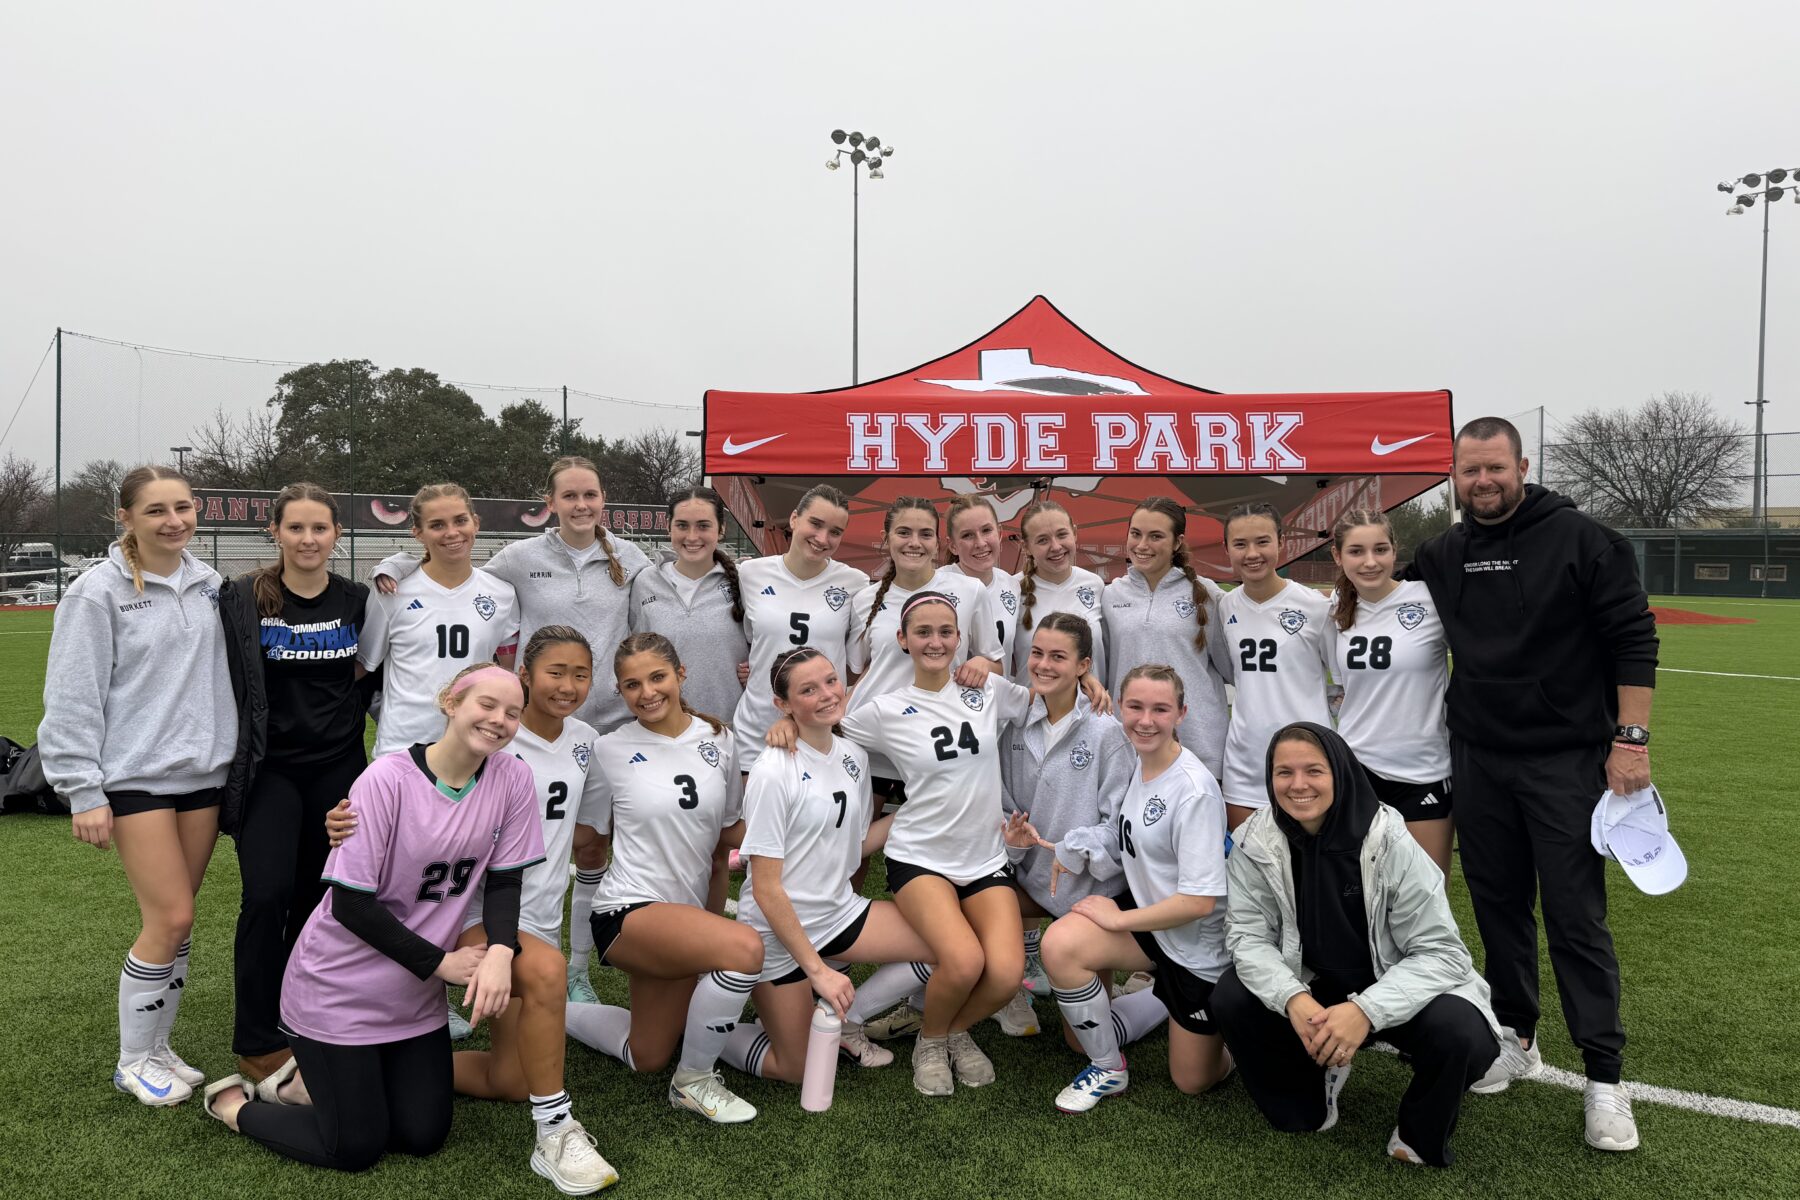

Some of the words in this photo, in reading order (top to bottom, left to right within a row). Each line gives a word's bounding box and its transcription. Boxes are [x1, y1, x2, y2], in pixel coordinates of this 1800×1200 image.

[847, 412, 1067, 472] HYDE
[1092, 412, 1307, 472] PARK
[600, 509, 669, 530] ASEBA
[529, 571, 552, 579] HERRIN
[119, 600, 152, 613] BURKETT
[260, 623, 358, 650] VOLLEYBALL
[436, 624, 470, 659] 10
[788, 611, 811, 646] 5
[282, 643, 358, 660] COUGARS
[1239, 638, 1278, 672] 22
[1346, 635, 1393, 670] 28
[930, 721, 980, 762] 24
[545, 780, 569, 820] 2
[673, 774, 699, 810] 3
[832, 790, 848, 829] 7
[1119, 814, 1137, 859] 16
[414, 856, 479, 903] 29
